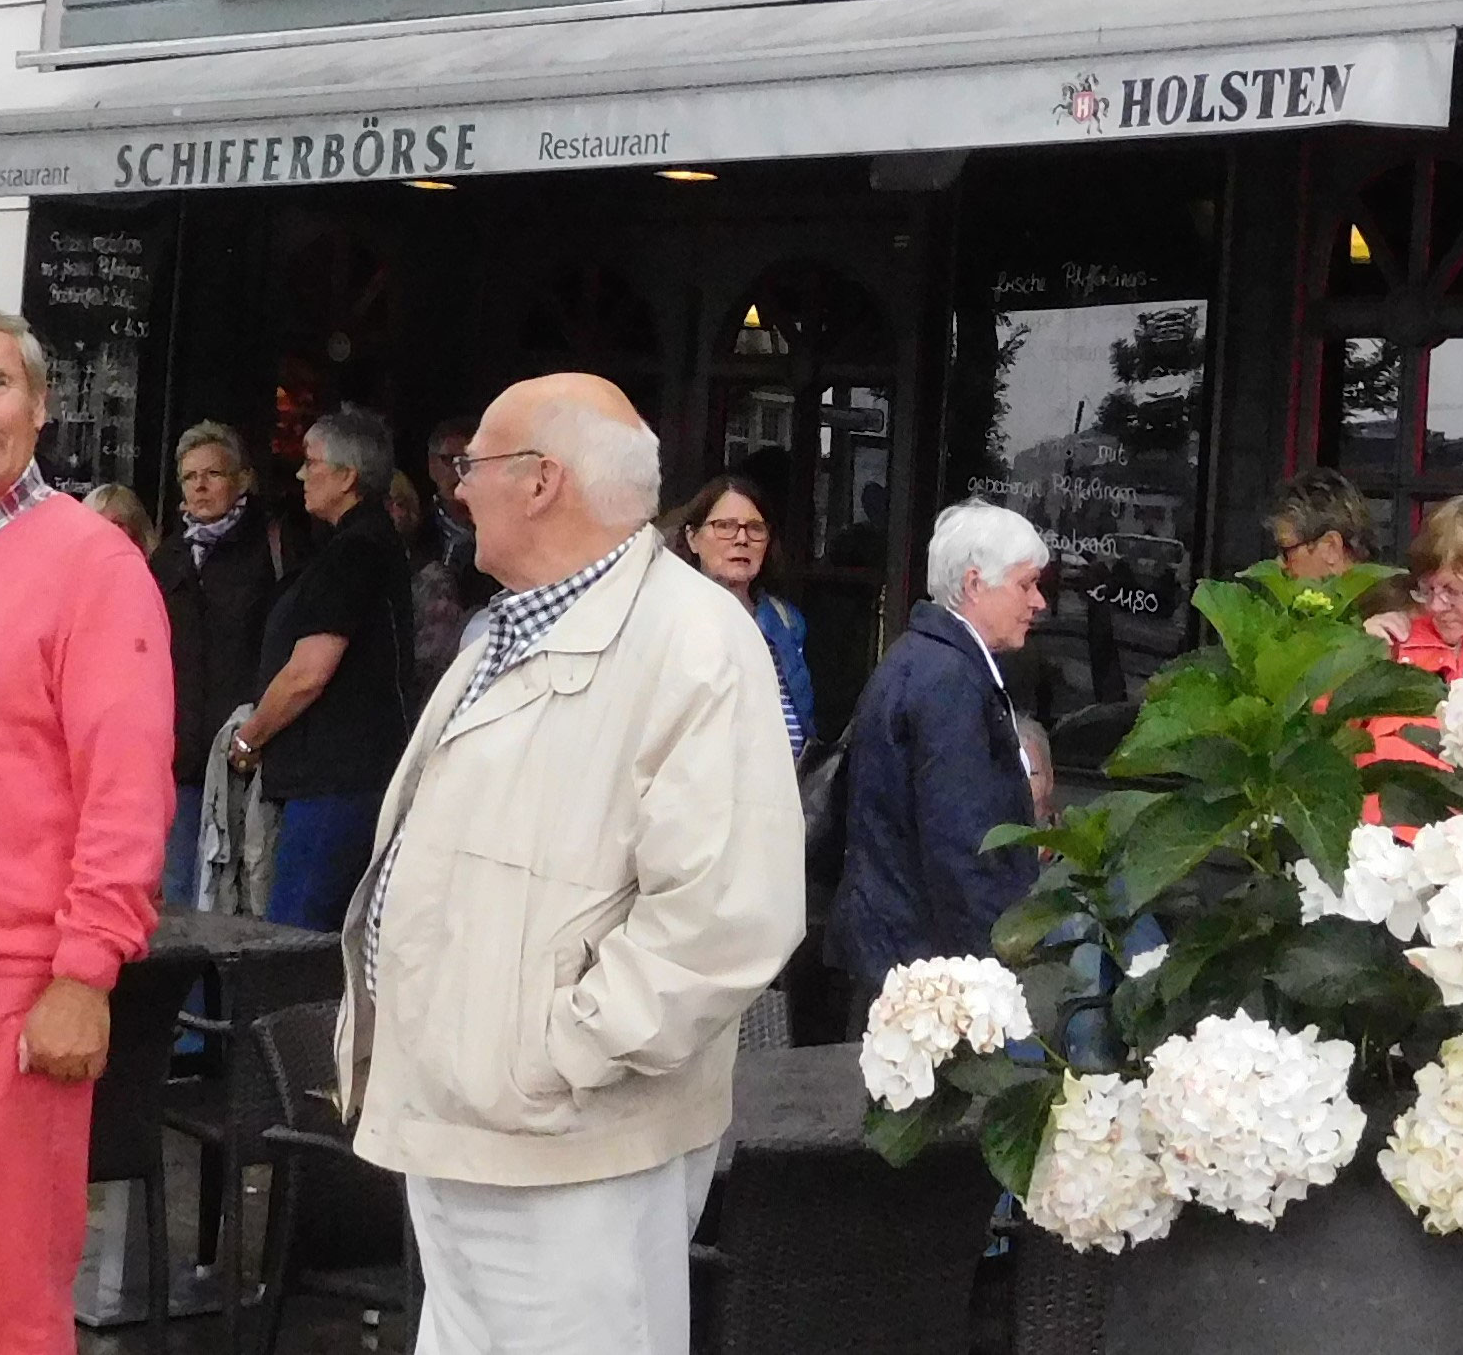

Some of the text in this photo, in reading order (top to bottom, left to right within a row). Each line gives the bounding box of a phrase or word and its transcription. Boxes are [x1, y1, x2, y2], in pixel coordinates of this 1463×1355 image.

[114, 116, 476, 188] SCHIFFERBÖRSE
[538, 129, 671, 161] Restaurant
[1119, 63, 1356, 129] HOLSTEN
